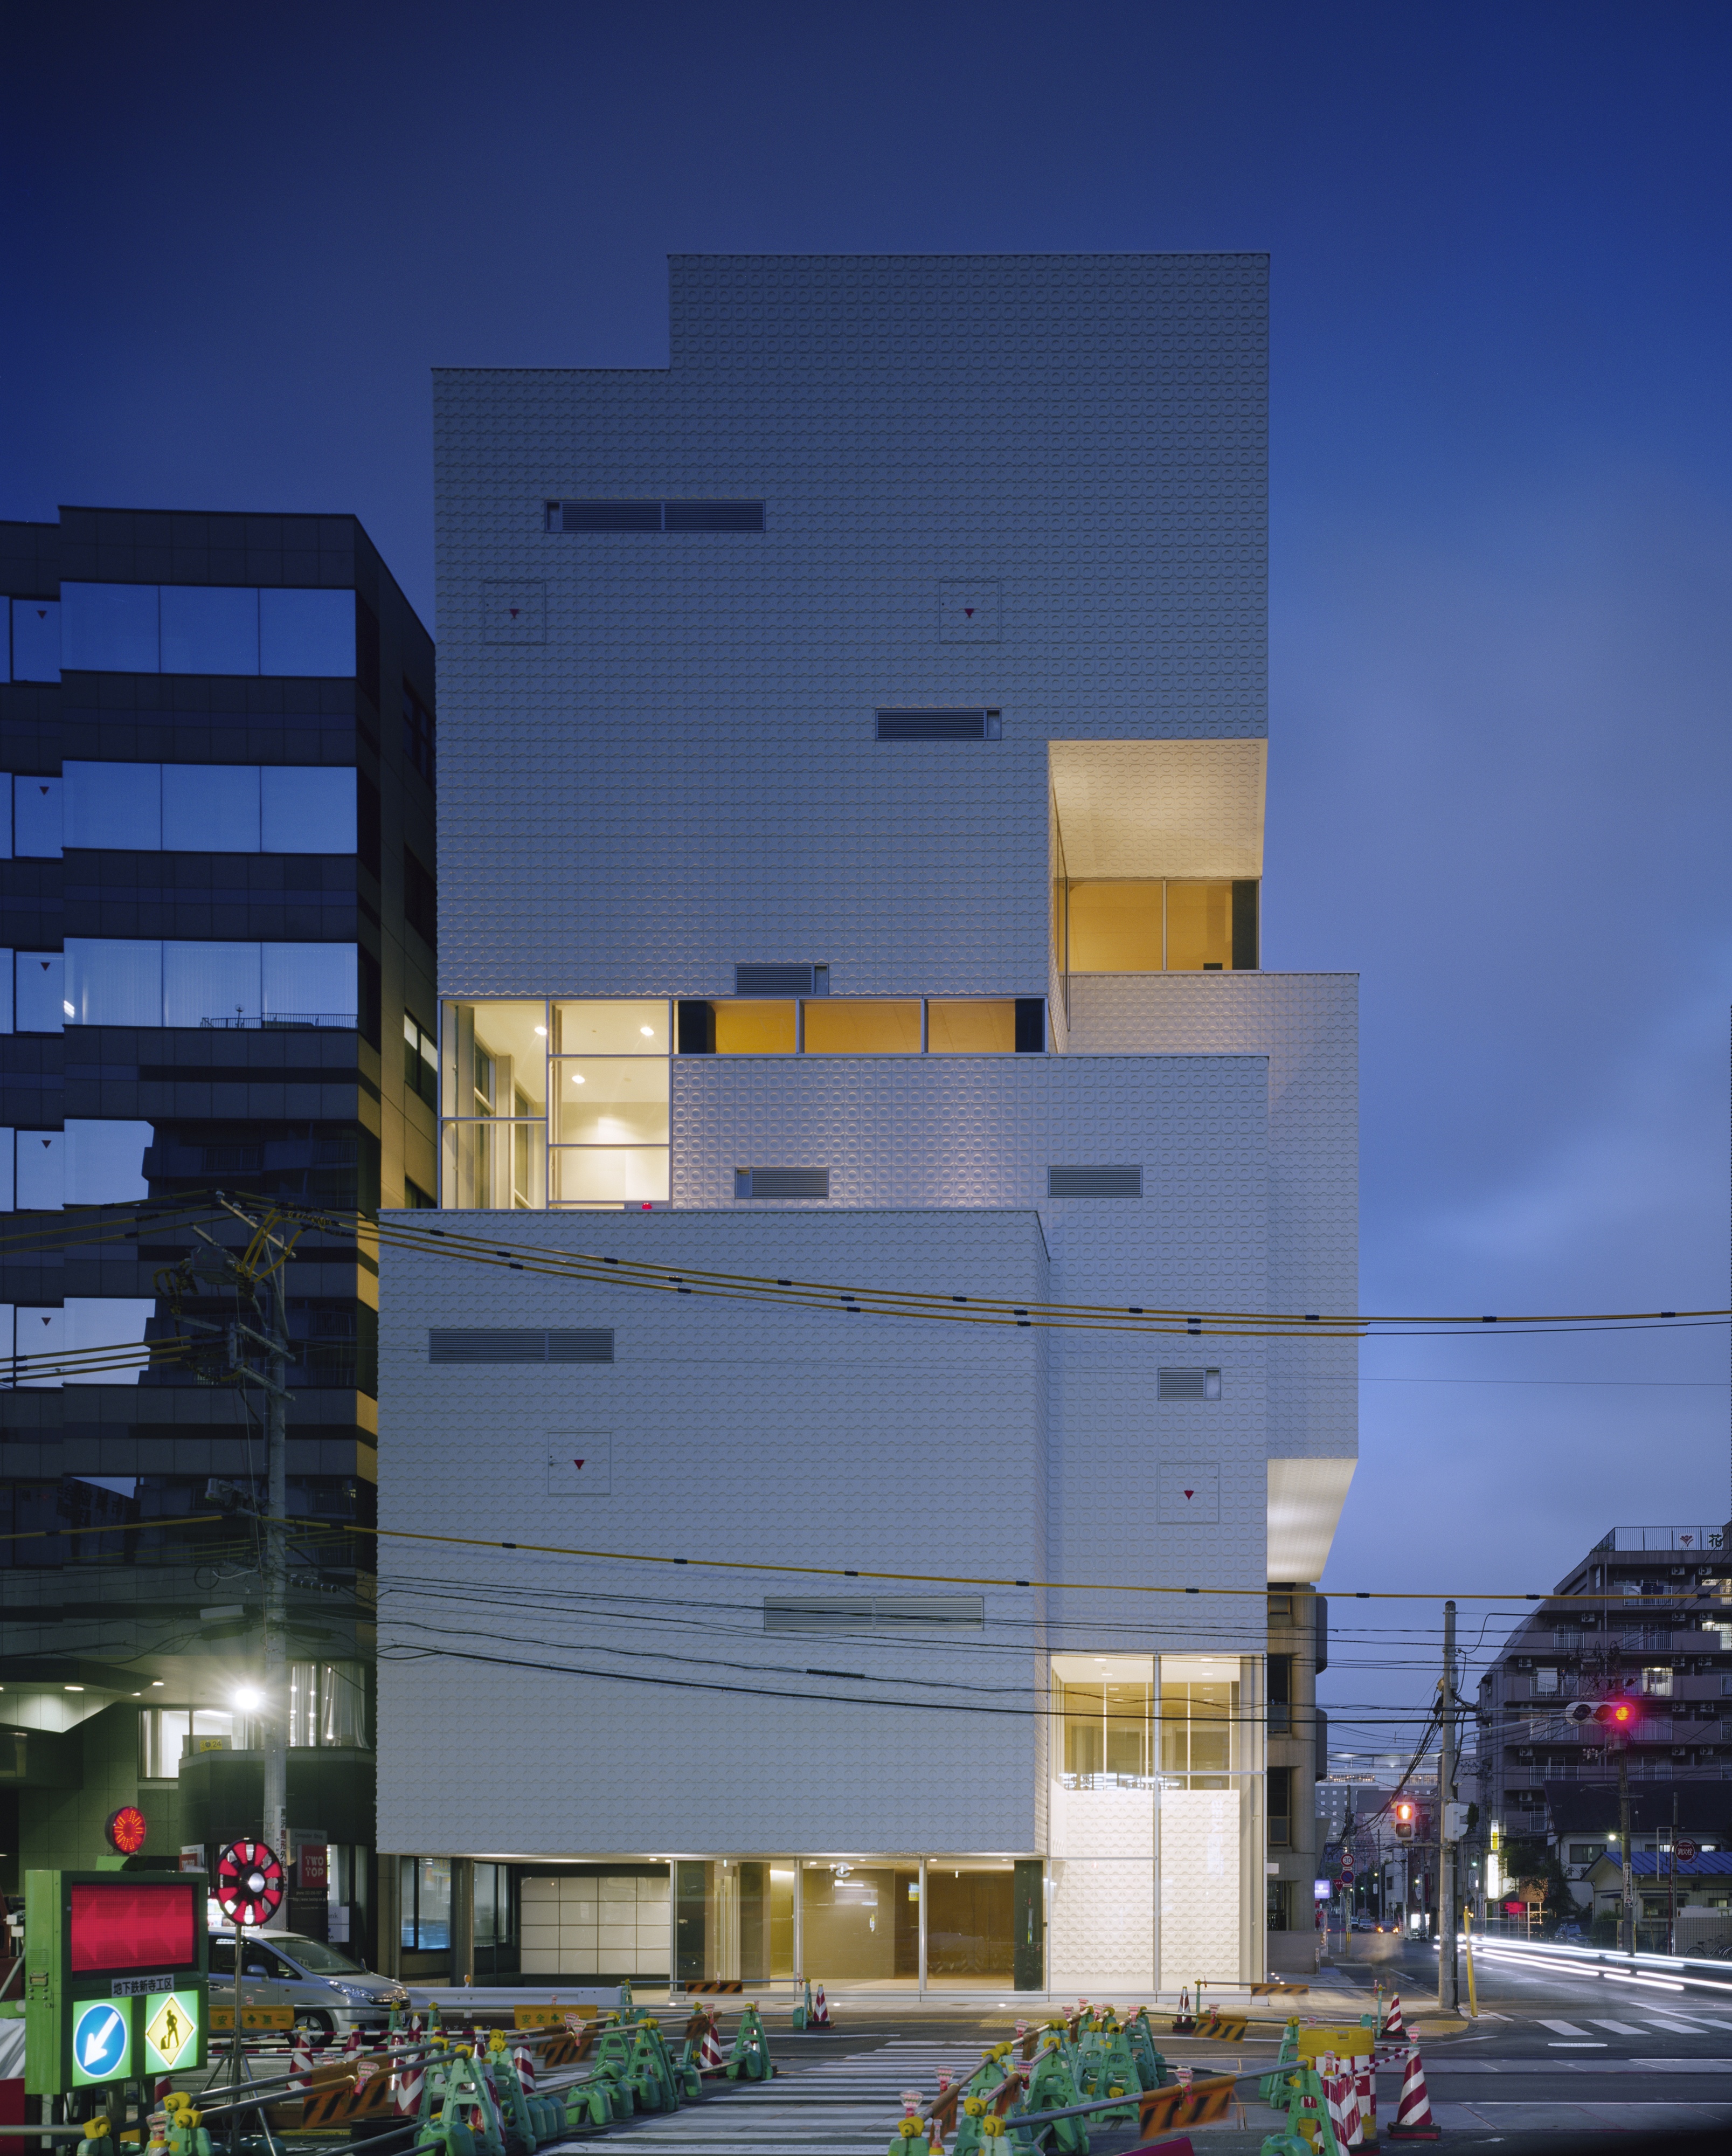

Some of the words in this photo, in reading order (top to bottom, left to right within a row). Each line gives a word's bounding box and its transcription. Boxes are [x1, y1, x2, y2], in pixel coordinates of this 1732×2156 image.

[1708, 1533, 1722, 1547] 花
[305, 1856, 324, 1866] TWO
[305, 1867, 324, 1877] TOP
[113, 1978, 172, 1995] 地下鉄新寺工区
[262, 2015, 286, 2024] 第一
[522, 2014, 545, 2024] 安全
